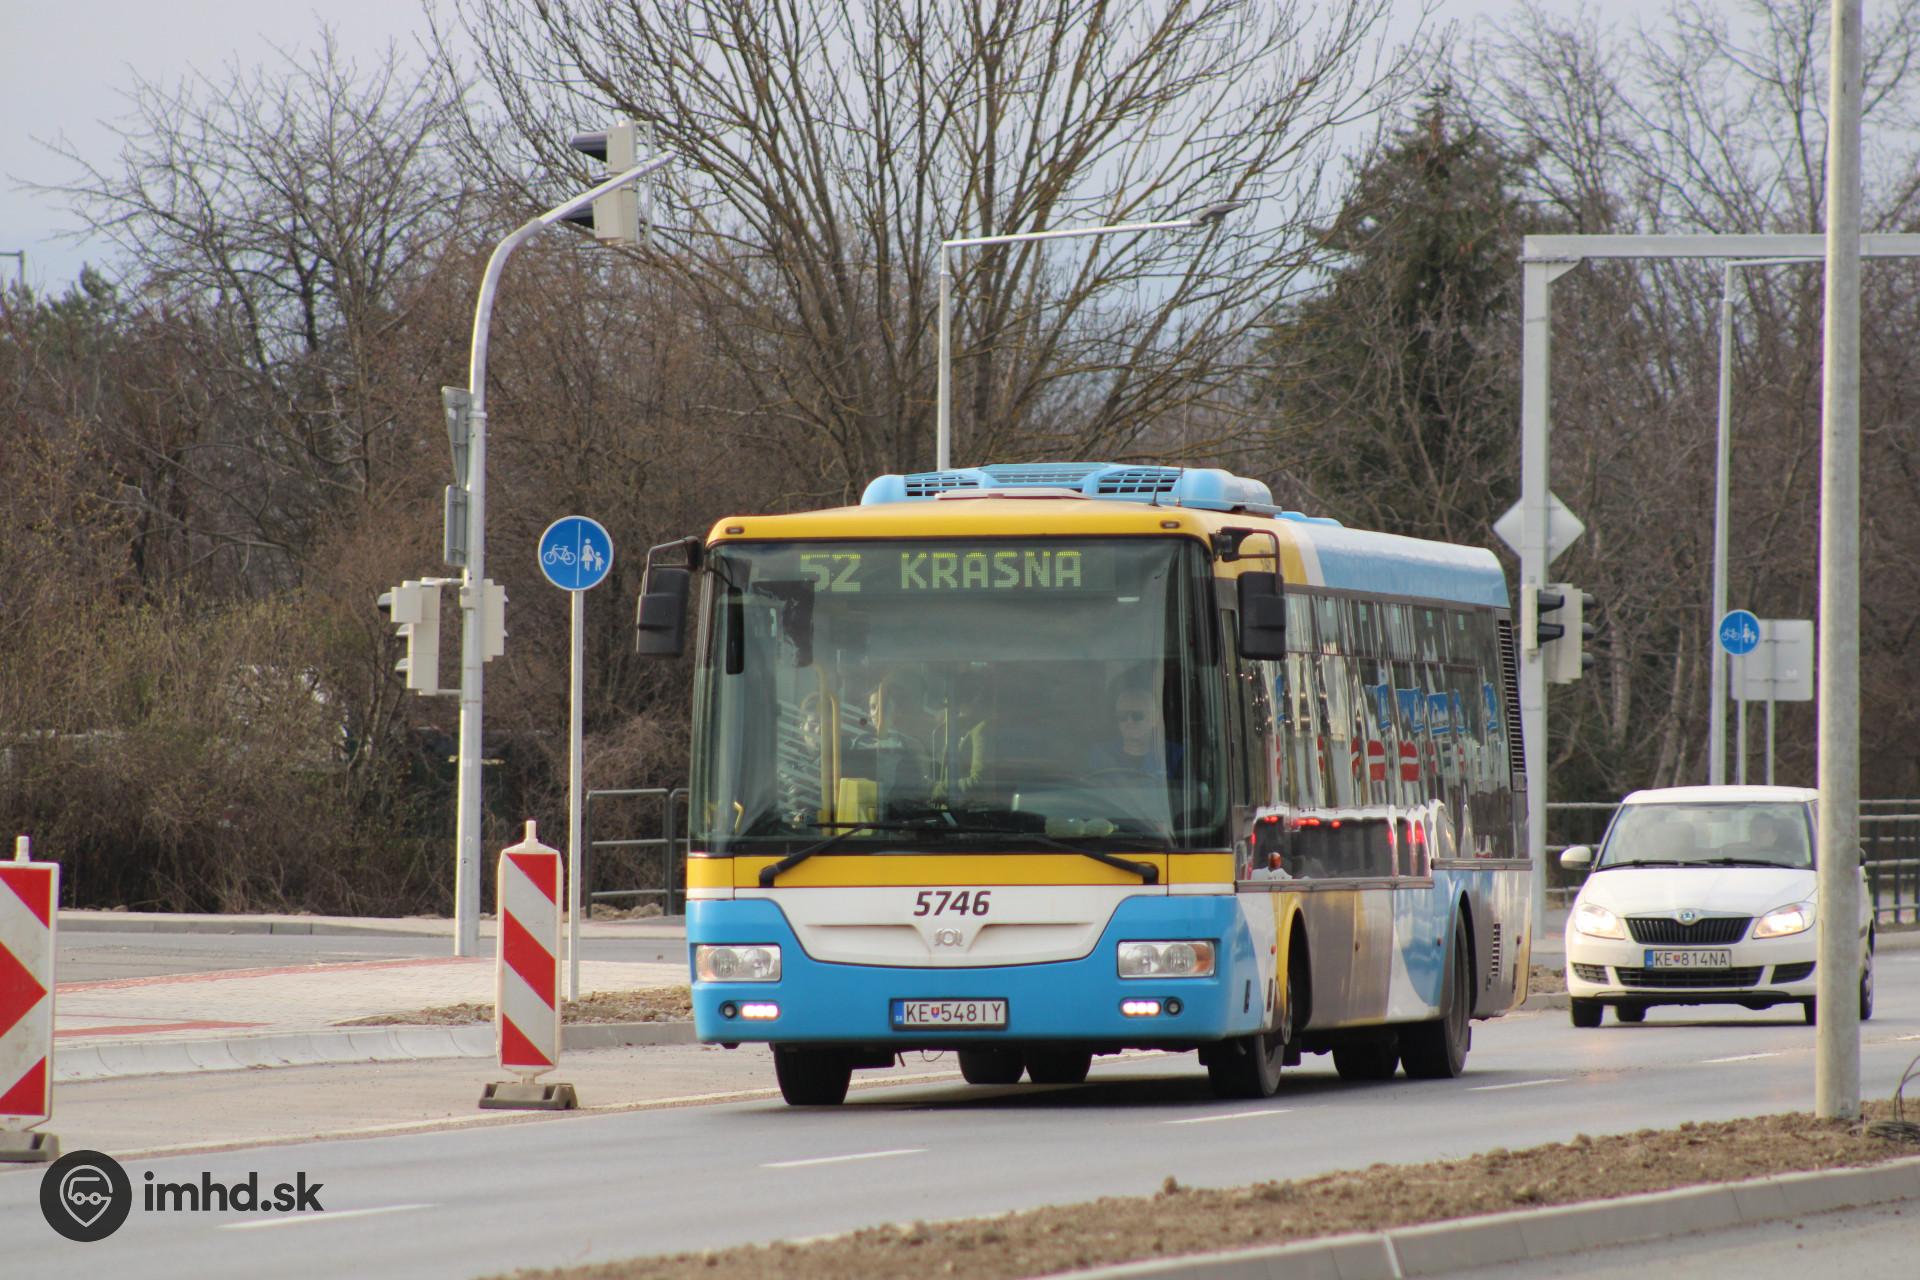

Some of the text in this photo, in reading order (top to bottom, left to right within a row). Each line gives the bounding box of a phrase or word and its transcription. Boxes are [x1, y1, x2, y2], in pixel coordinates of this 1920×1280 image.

[800, 551, 1082, 592] 52 KRASNA
[913, 890, 991, 917] 5746
[1655, 952, 1728, 966] KE 814NA
[906, 1003, 1002, 1022] KE 548IY
